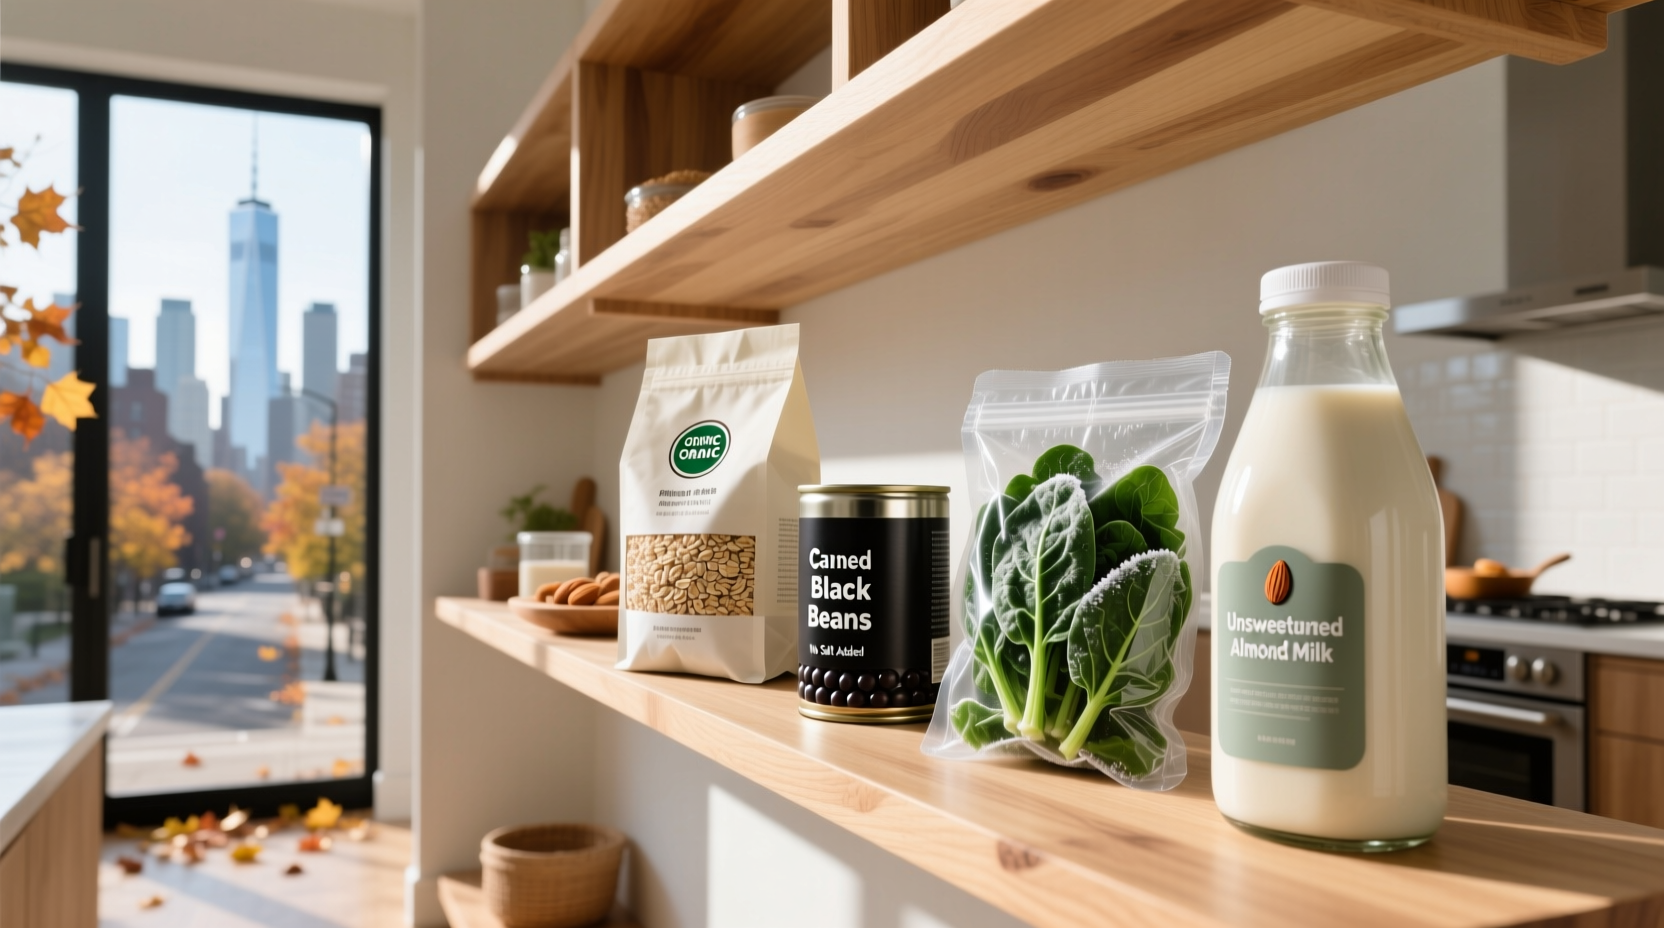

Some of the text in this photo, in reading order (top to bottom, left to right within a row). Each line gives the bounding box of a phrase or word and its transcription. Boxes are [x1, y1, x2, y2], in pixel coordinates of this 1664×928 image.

[811, 575, 872, 601] Black
[808, 604, 872, 631] Beans
[1229, 637, 1334, 664] Almond Milk
